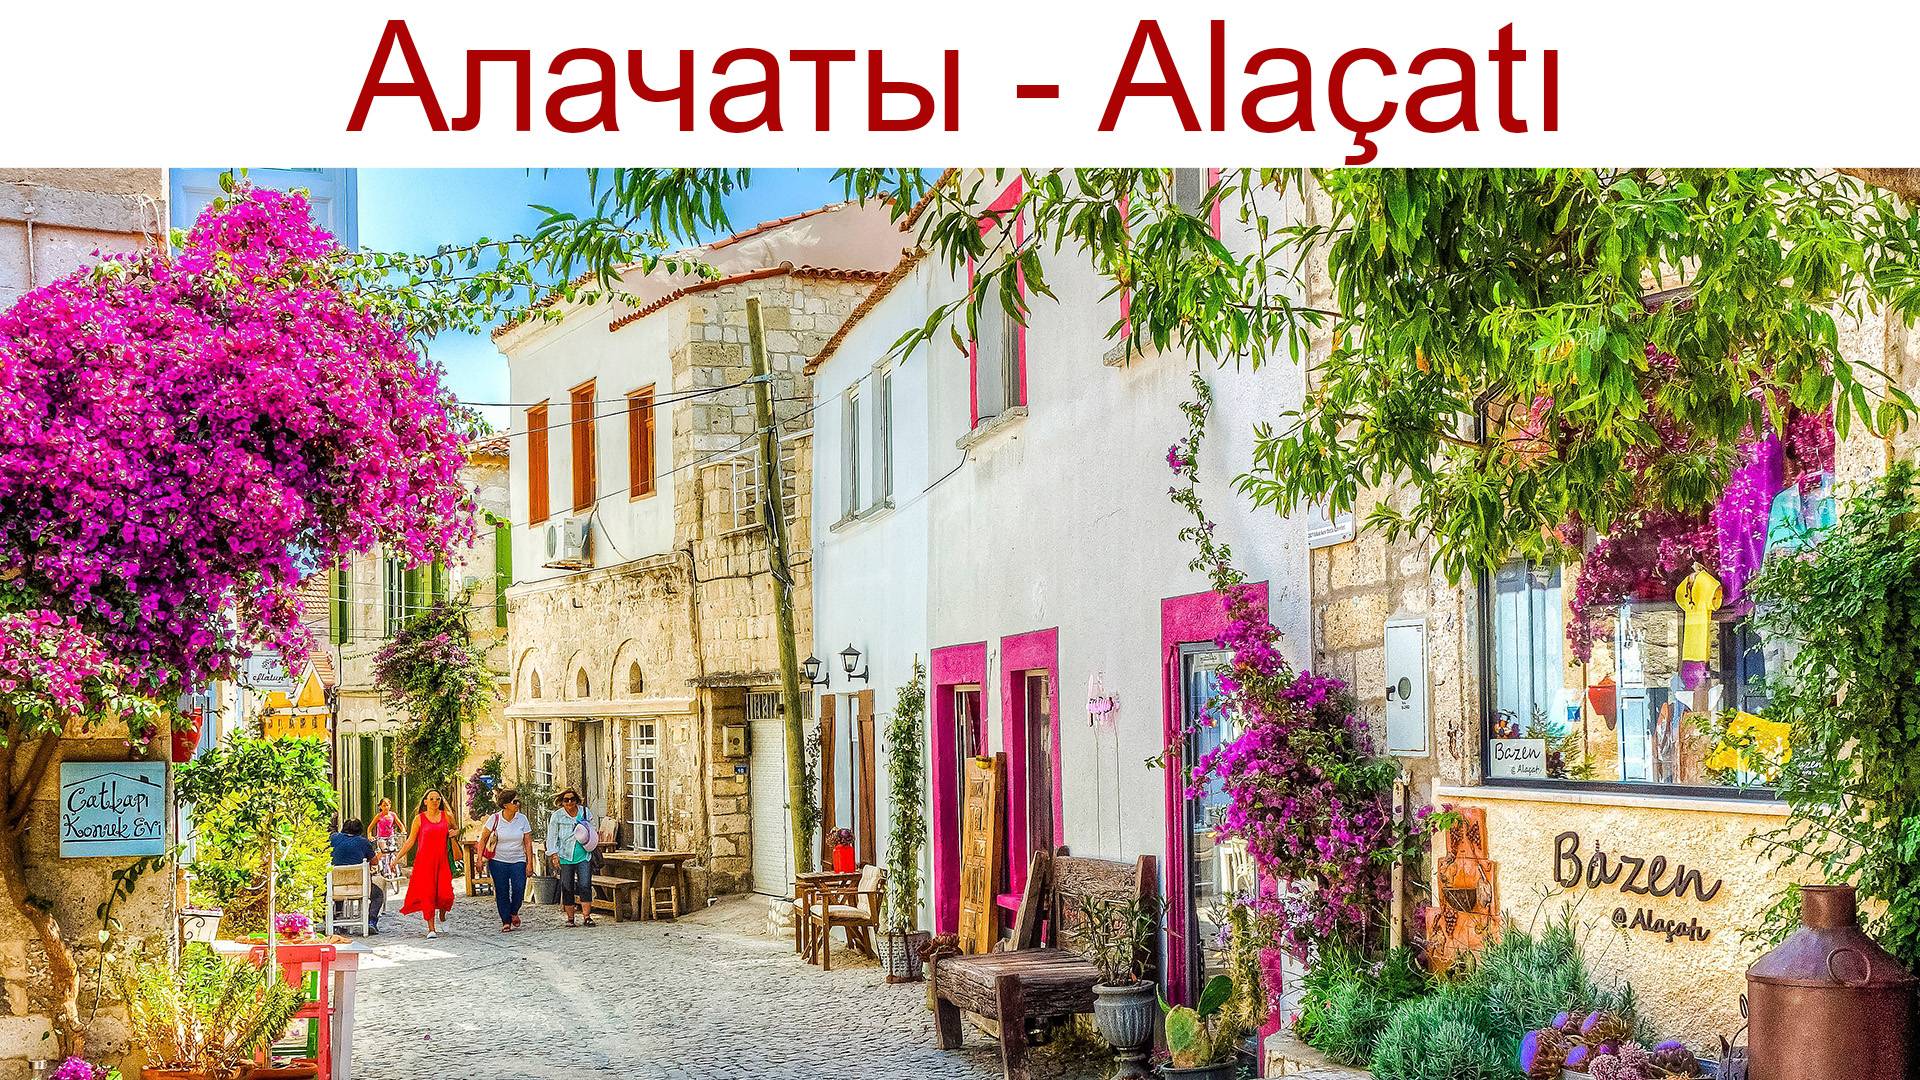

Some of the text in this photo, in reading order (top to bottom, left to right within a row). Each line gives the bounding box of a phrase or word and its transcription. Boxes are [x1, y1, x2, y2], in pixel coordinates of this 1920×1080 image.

[1495, 742, 1541, 760] Bazen
[67, 781, 149, 815] Çatkapı
[63, 814, 161, 839] Konuk Evi
[1554, 831, 1722, 902] Bazen
[1612, 907, 1711, 942] @ Alaçatı
